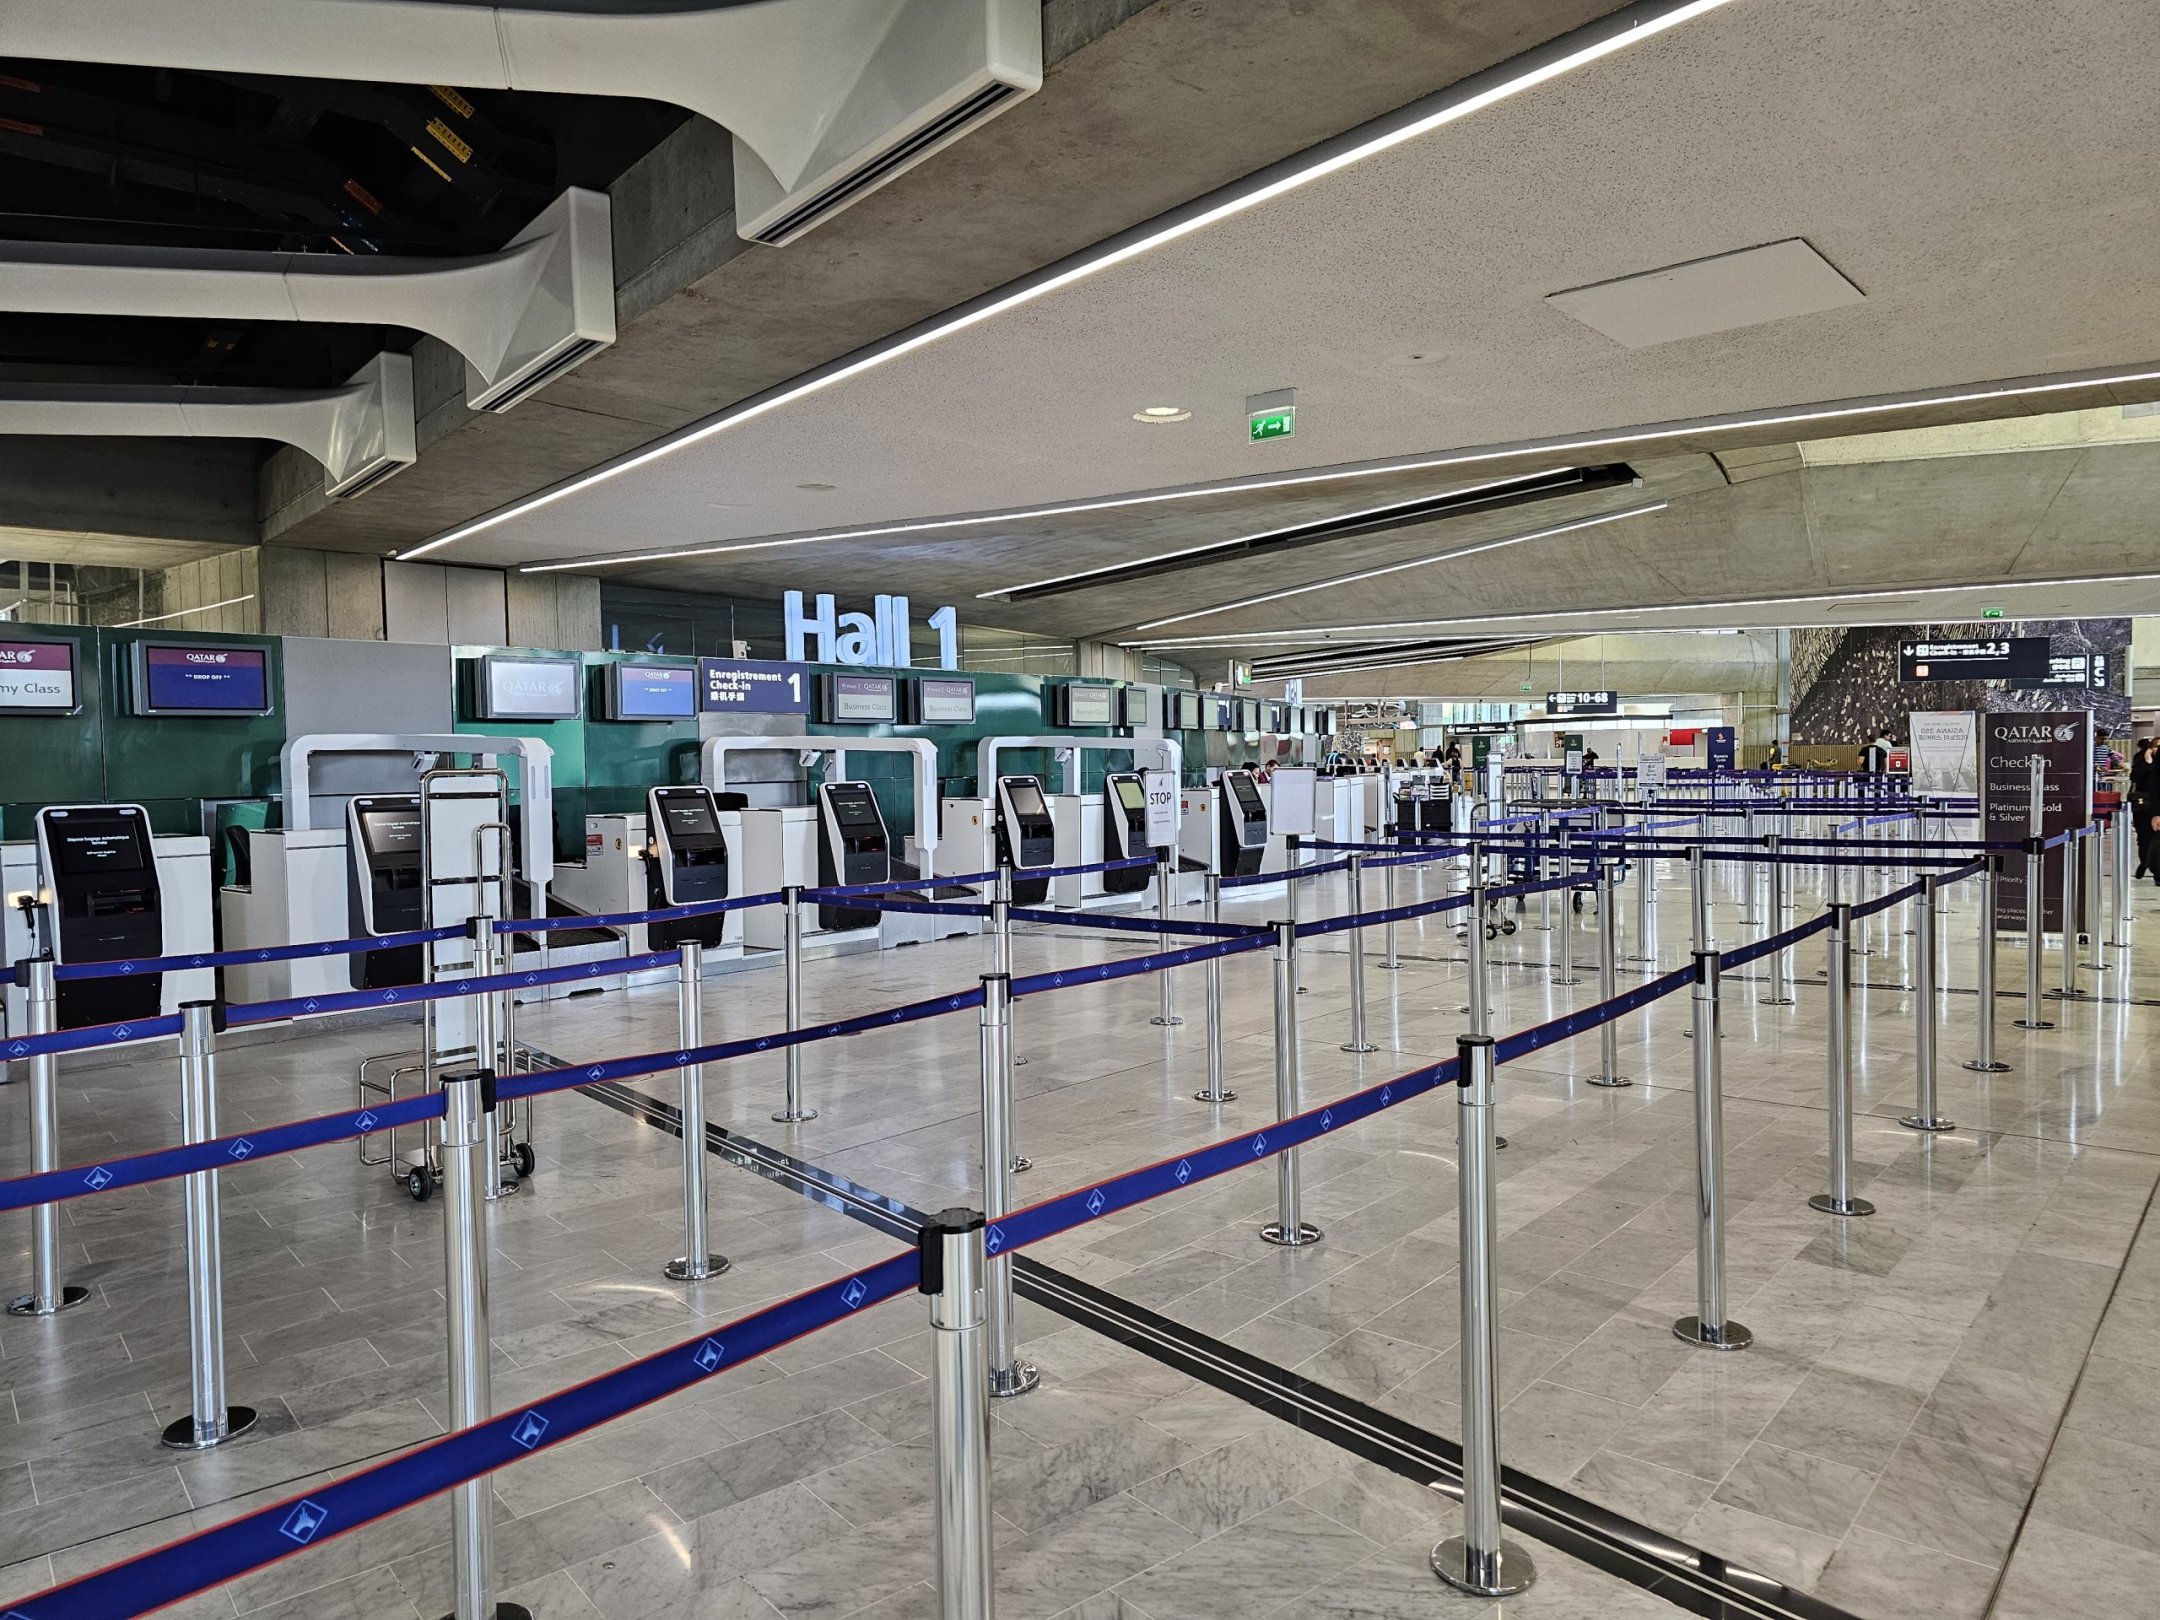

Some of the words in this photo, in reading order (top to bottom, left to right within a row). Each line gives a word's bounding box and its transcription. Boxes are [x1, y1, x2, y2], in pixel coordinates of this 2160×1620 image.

[783, 590, 911, 667] Hall
[927, 606, 958, 671] 1
[186, 653, 216, 662] QATAR
[709, 669, 782, 682] Enregistrement
[24, 683, 61, 694] Class
[503, 680, 546, 694] QATAR
[709, 680, 752, 691] Check-in
[787, 672, 801, 703] 1
[1577, 692, 1609, 703] 10-68
[844, 702, 871, 711] Business
[1994, 726, 2052, 741] QATAR
[1990, 756, 2052, 768] Checkn
[1990, 783, 2031, 791] Business
[1150, 792, 1172, 805] STOP
[1989, 813, 1996, 821] &
[1999, 813, 2025, 821] Silver
[2000, 876, 2024, 884] Priority
